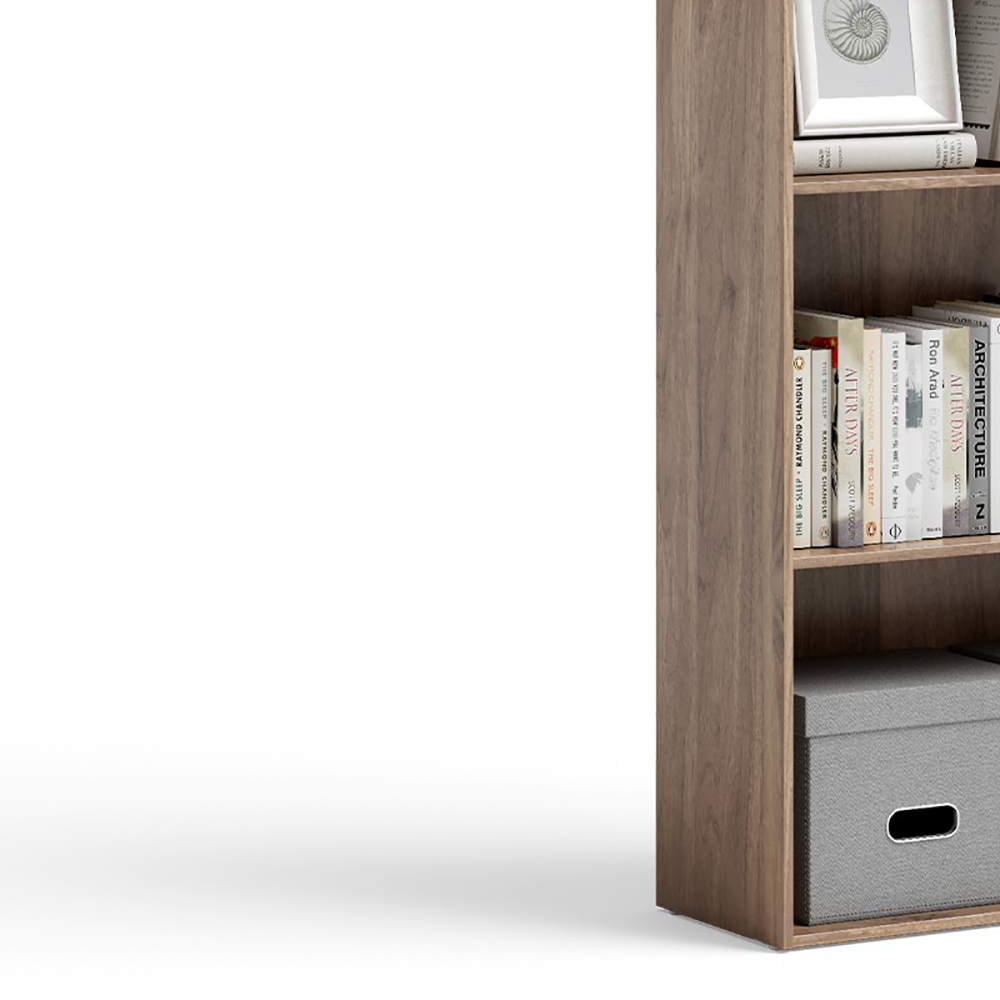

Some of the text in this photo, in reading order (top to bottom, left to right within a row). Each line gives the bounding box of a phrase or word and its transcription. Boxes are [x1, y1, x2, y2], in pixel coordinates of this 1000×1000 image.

[929, 339, 940, 399] Ron Arad
[795, 377, 803, 421] CHANDLER
[844, 368, 859, 456] AFTER DAYS
[950, 374, 964, 453] AFTER DAYS
[974, 339, 986, 478] ARCHITECTURE
[795, 423, 803, 467] RAYMOND
[867, 448, 875, 465] THE
[867, 467, 875, 481] BIG
[867, 483, 875, 507] SLEEP
